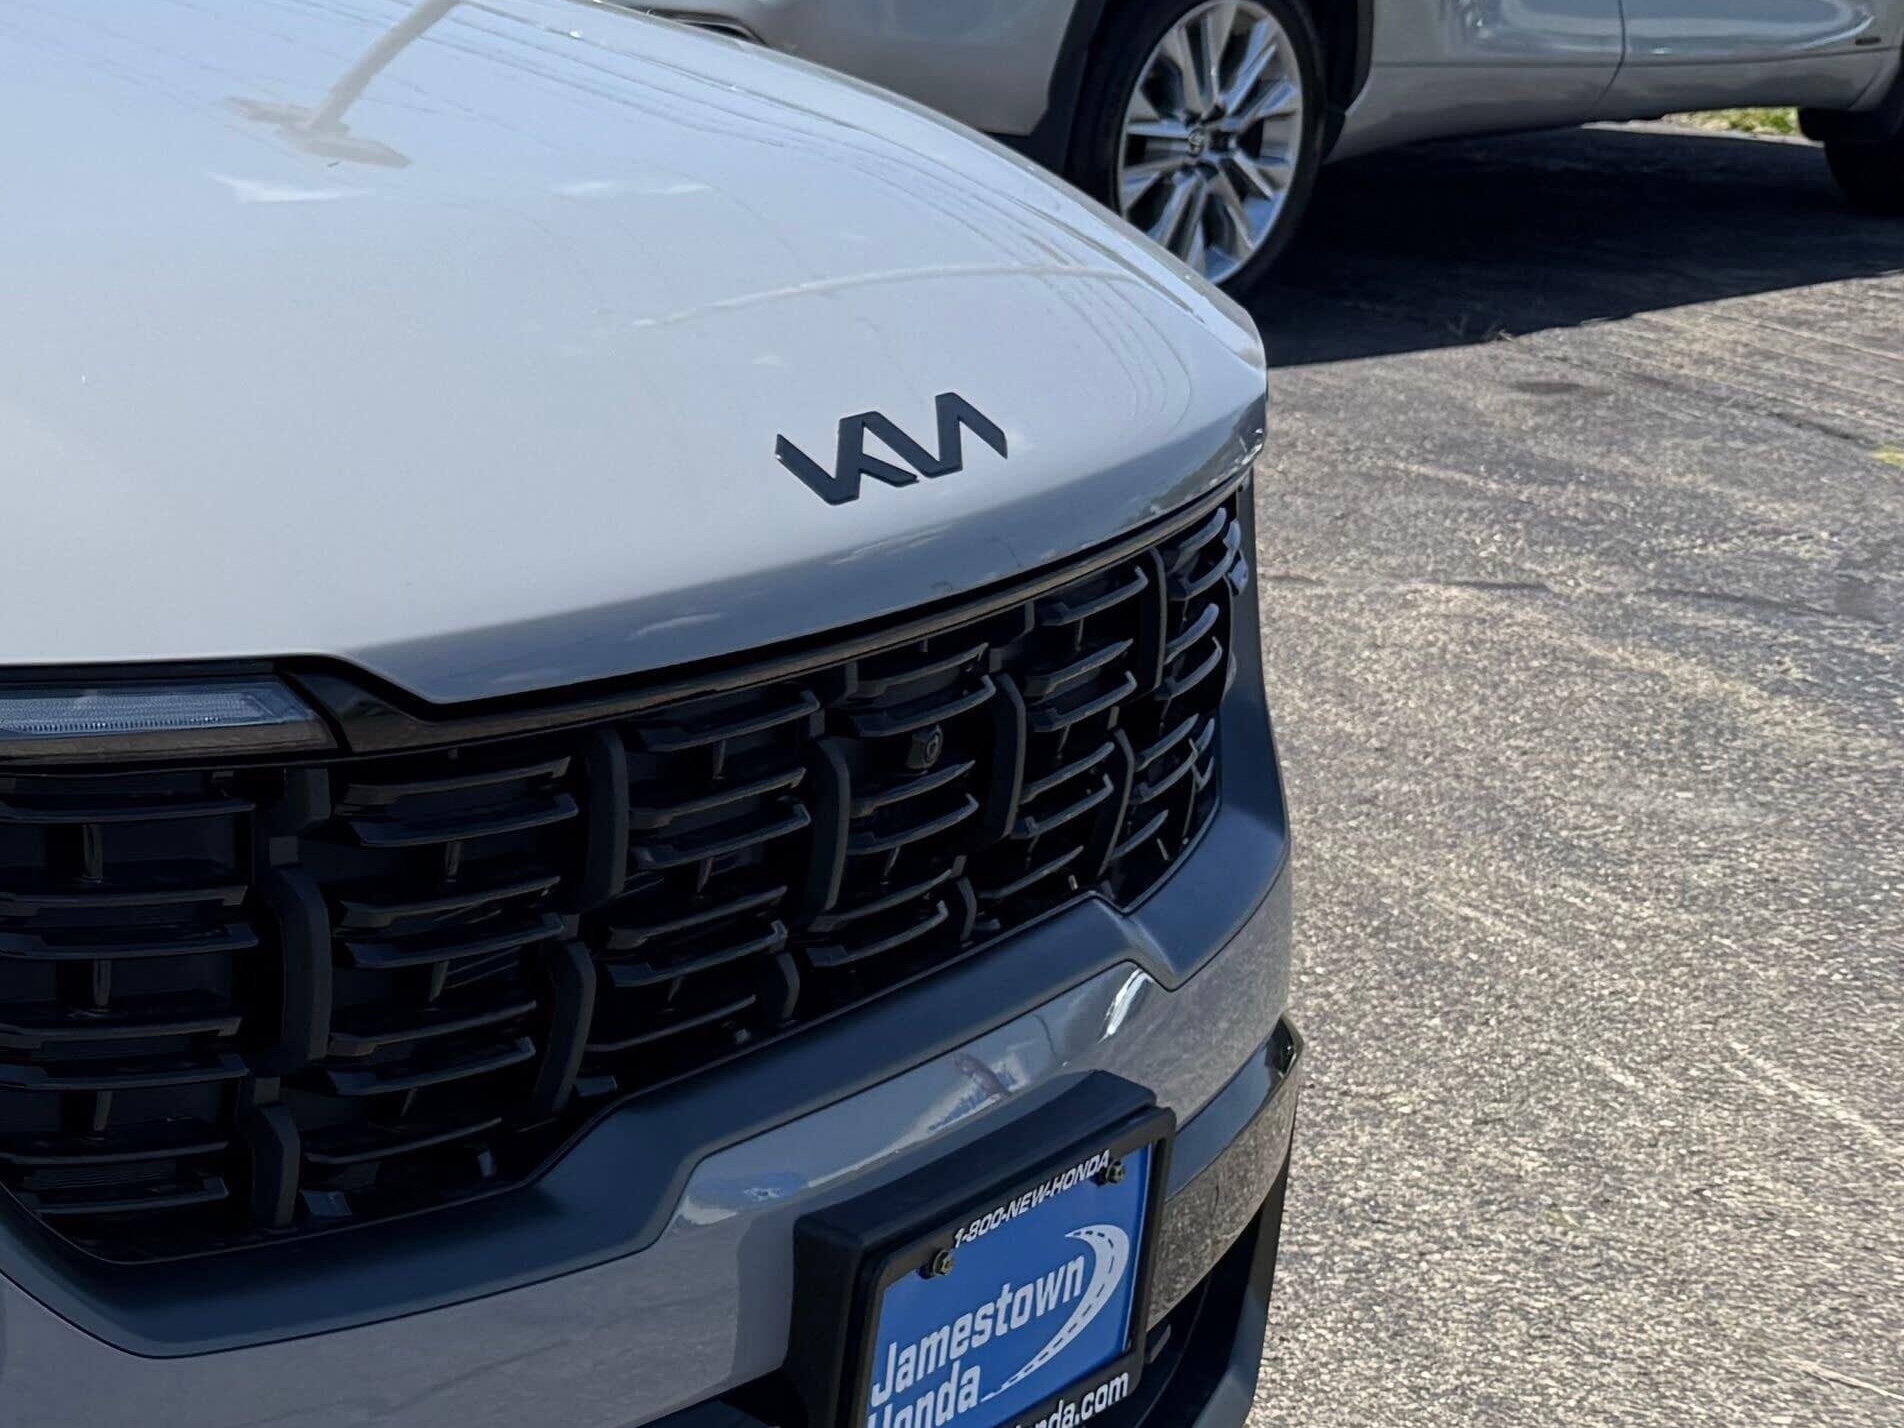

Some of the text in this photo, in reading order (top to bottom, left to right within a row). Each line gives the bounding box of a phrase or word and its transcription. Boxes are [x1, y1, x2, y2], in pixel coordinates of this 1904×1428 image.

[775, 391, 1008, 505] KIA
[953, 1149, 1112, 1248] 1-800-NEW-HONDA
[872, 1254, 1086, 1407] Jamestown
